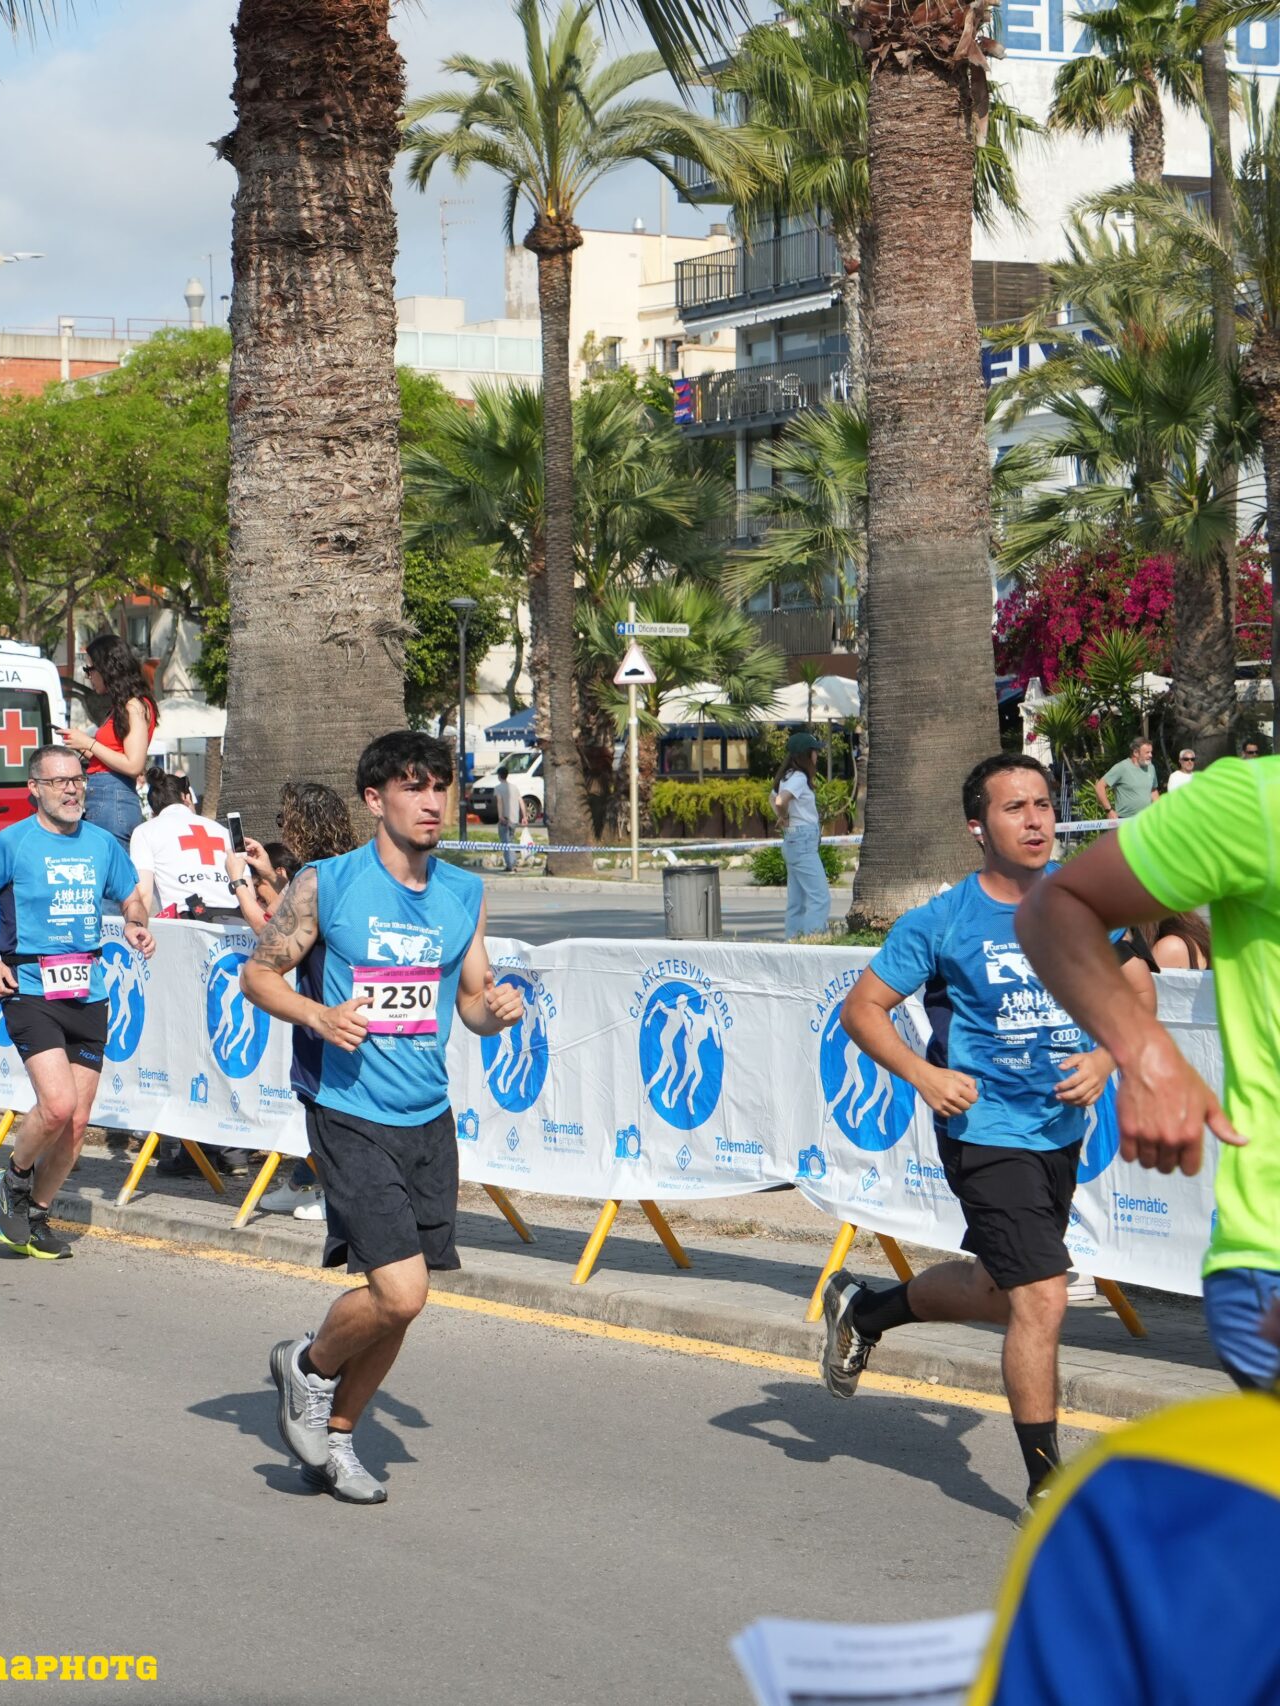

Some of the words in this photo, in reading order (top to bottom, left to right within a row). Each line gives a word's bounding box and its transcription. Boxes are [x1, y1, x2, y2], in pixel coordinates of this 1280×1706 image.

[638, 624, 658, 633] Oficina
[666, 626, 687, 634] turisme
[214, 872, 229, 883] Ro
[989, 942, 1008, 951] Cursa
[48, 966, 89, 984] 1035
[364, 985, 432, 1009] 1230
[629, 959, 733, 1030] C.A.ATLETESVNG.ORG
[993, 1057, 1031, 1065] PENDENNIS
[138, 1068, 169, 1082] Telemàtic
[259, 1084, 293, 1100] Telemàtic
[542, 1119, 584, 1136] Telemàtic
[715, 1137, 764, 1155] Telemàtic
[905, 1159, 945, 1180] Telemàt
[1113, 1192, 1168, 1214] Telemàtic
